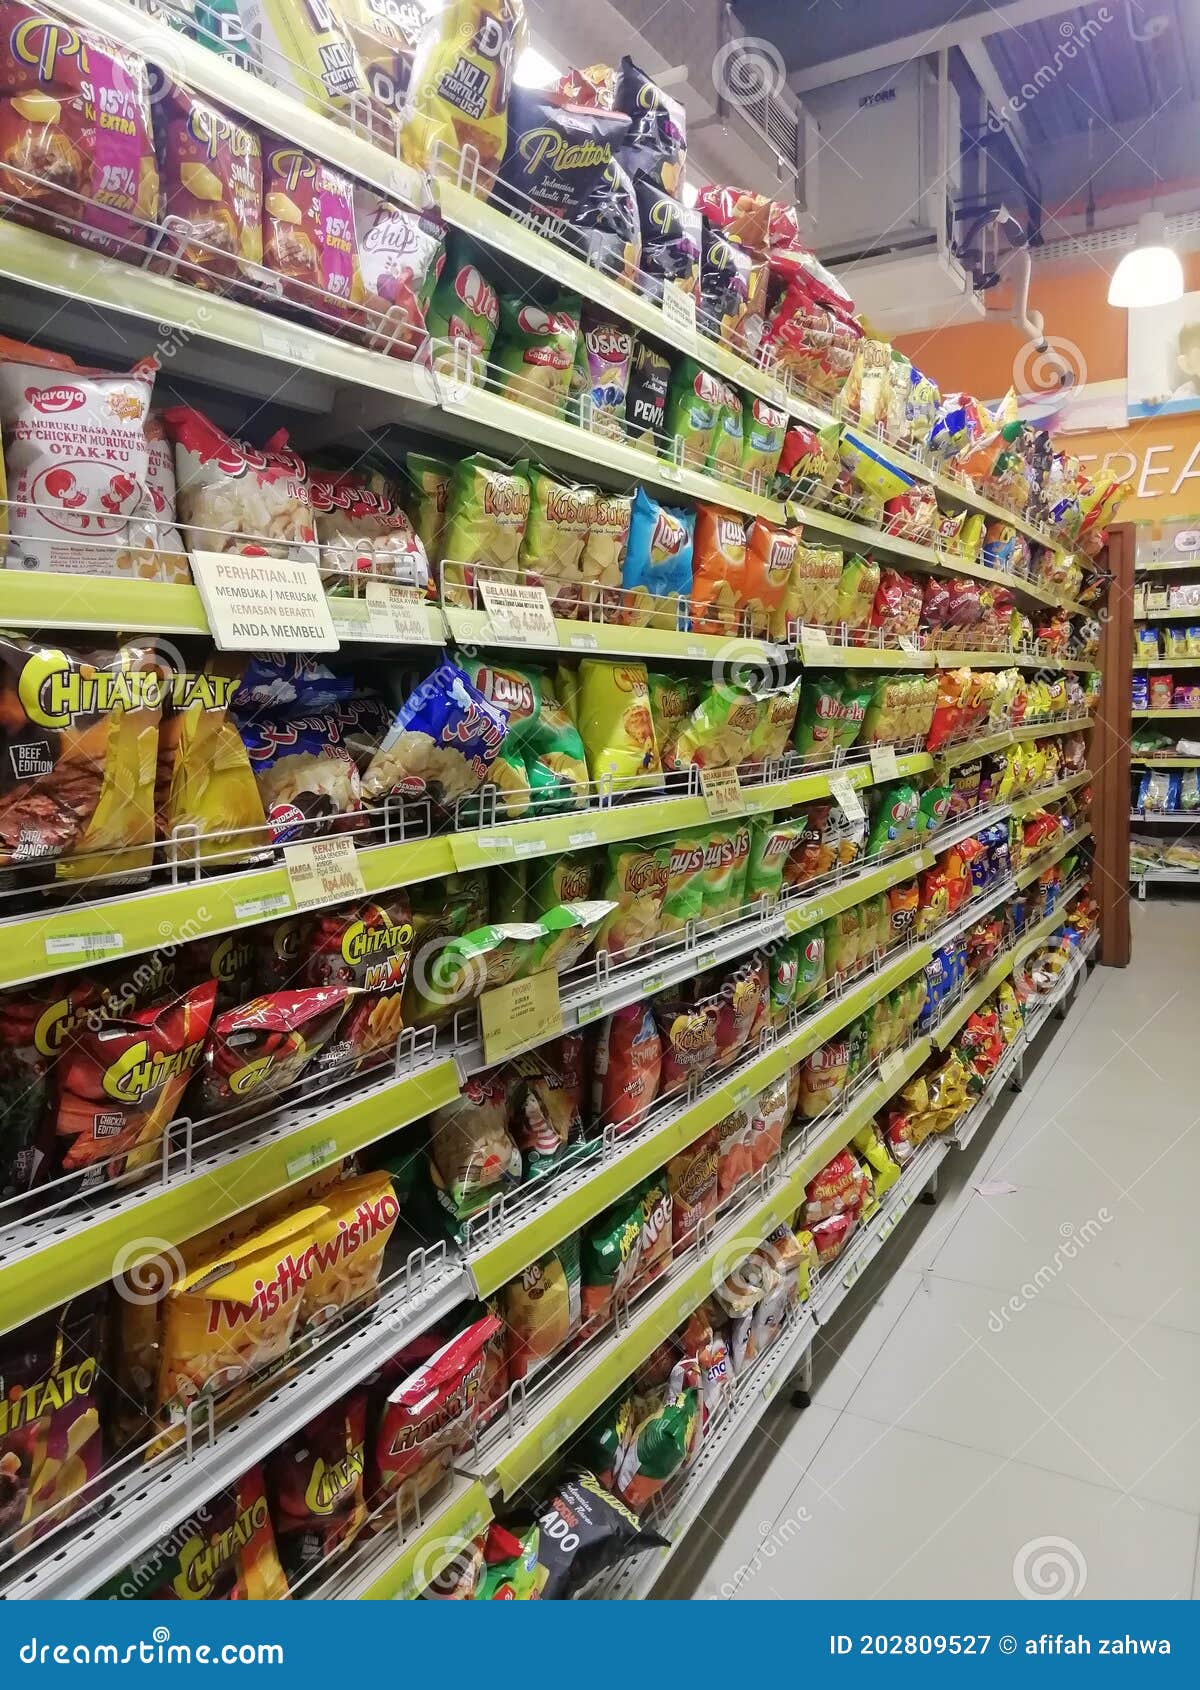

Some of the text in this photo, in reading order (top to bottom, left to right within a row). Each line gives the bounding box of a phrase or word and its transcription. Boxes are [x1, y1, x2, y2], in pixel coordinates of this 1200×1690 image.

[99, 111, 136, 136] EXTRA
[31, 389, 84, 405] Naraya
[32, 420, 79, 432] MURUKU
[81, 425, 109, 436] RASA
[110, 427, 137, 438] AYAM
[35, 429, 88, 445] CHICKEN
[90, 434, 135, 450] MURUKU
[49, 442, 130, 462] OTAK-KU
[286, 477, 309, 504] ne
[215, 586, 268, 600] MEMBUKA
[275, 590, 319, 603] MERUSAK
[230, 603, 316, 618] KEMASAN BERARTI
[232, 623, 325, 639] ANDA MEMBELI
[476, 668, 534, 714] Lay's
[18, 746, 42, 760] BEEF
[18, 760, 53, 774] EDITION
